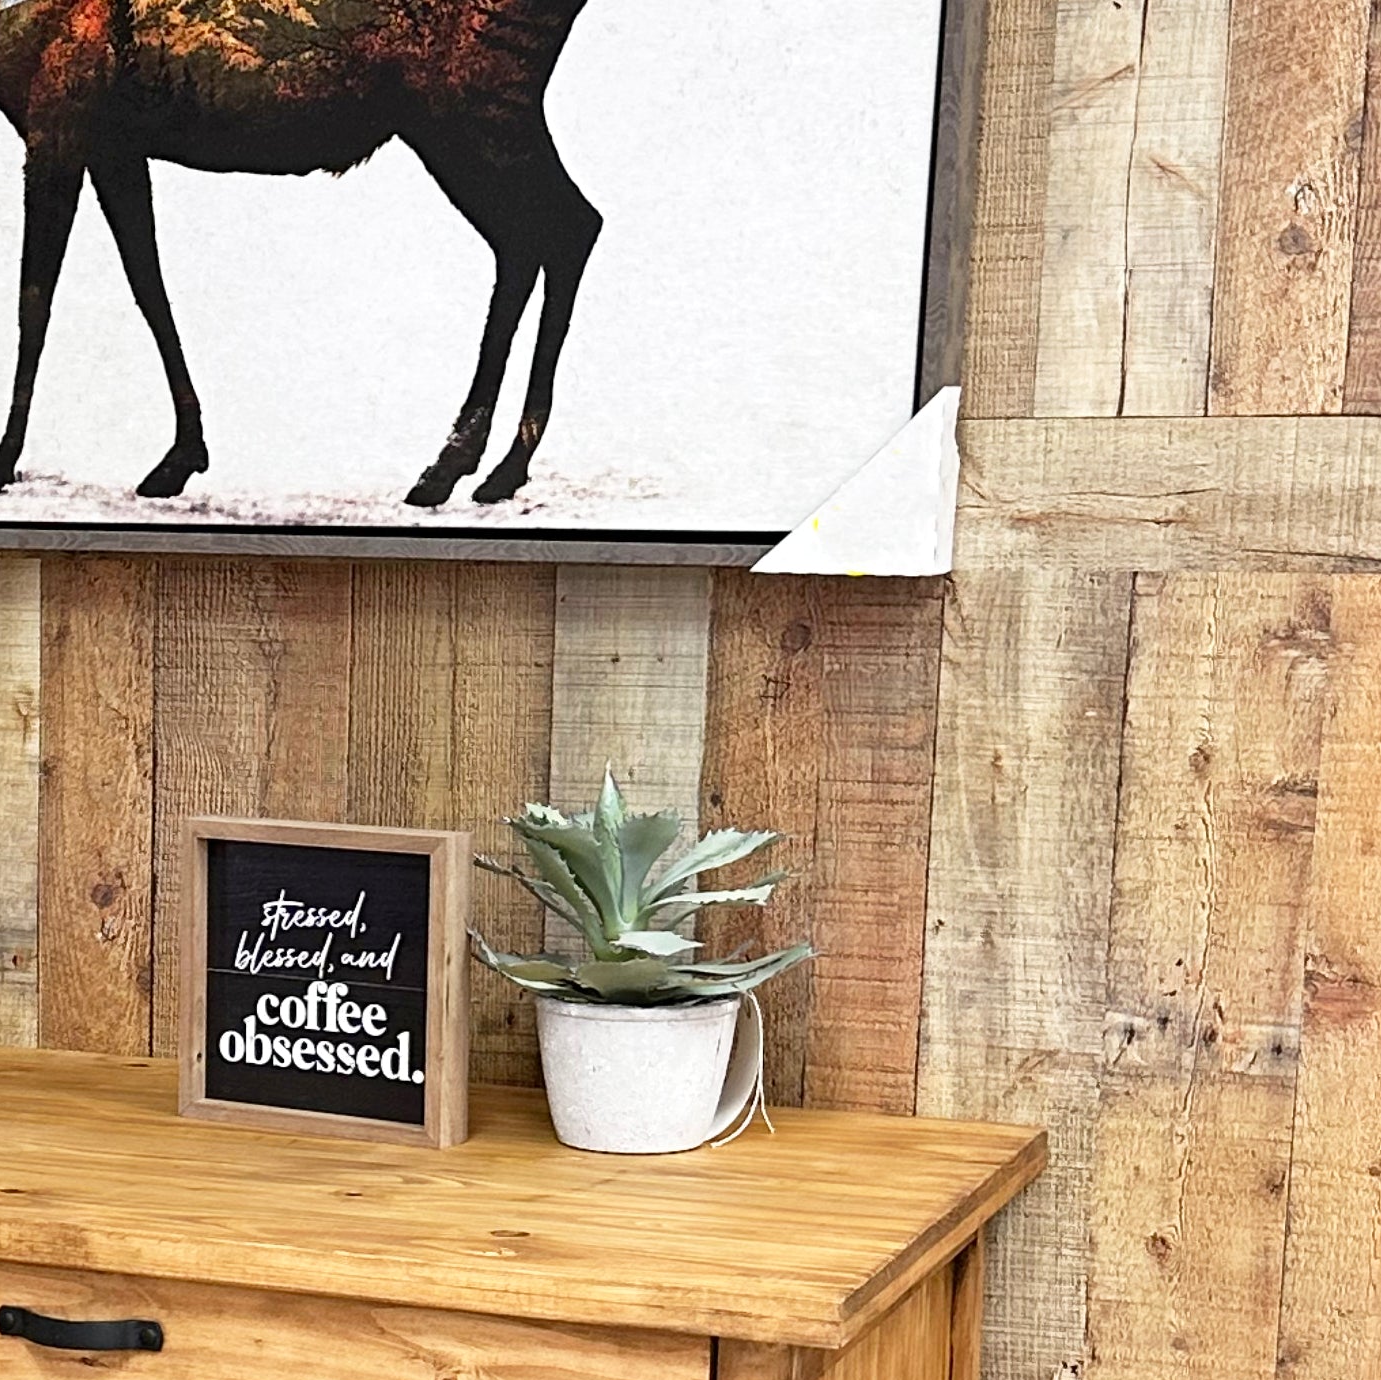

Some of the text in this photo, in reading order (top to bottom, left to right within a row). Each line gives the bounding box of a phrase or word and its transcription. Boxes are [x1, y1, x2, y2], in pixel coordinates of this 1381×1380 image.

[261, 889, 366, 941] stressed,
[234, 930, 401, 980] blessed, and
[256, 981, 388, 1036] coffee
[219, 1015, 425, 1084] obsessed.
